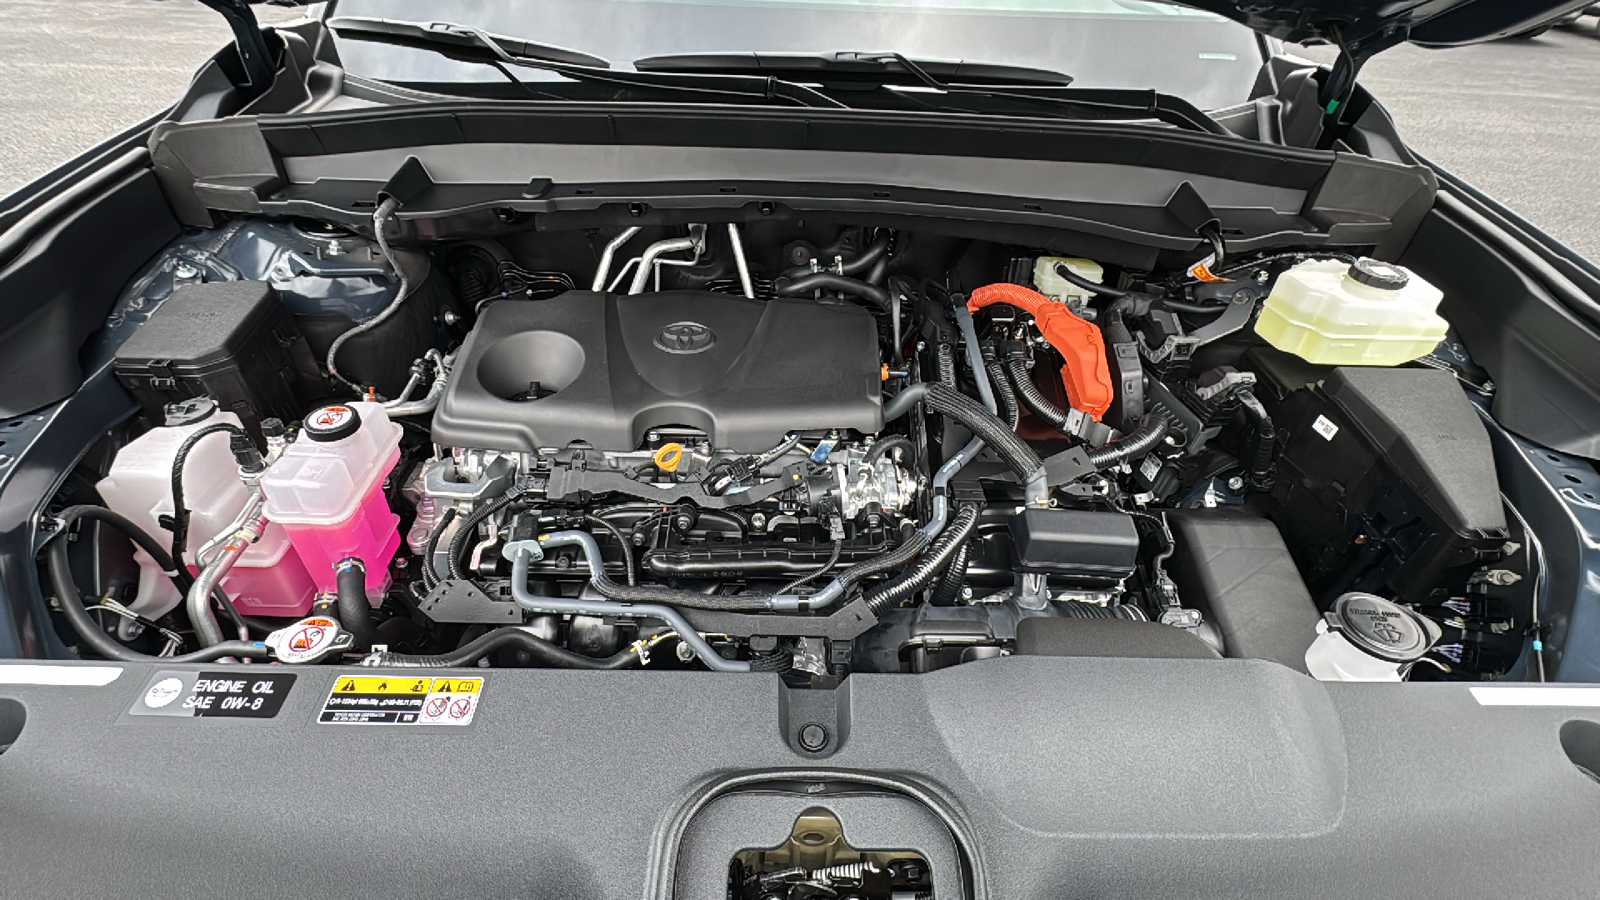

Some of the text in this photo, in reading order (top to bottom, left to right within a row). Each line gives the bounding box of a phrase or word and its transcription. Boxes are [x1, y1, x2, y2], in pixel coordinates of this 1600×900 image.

[192, 679, 275, 694] ENGINE OIL
[182, 695, 264, 711] SAE 0W-8
